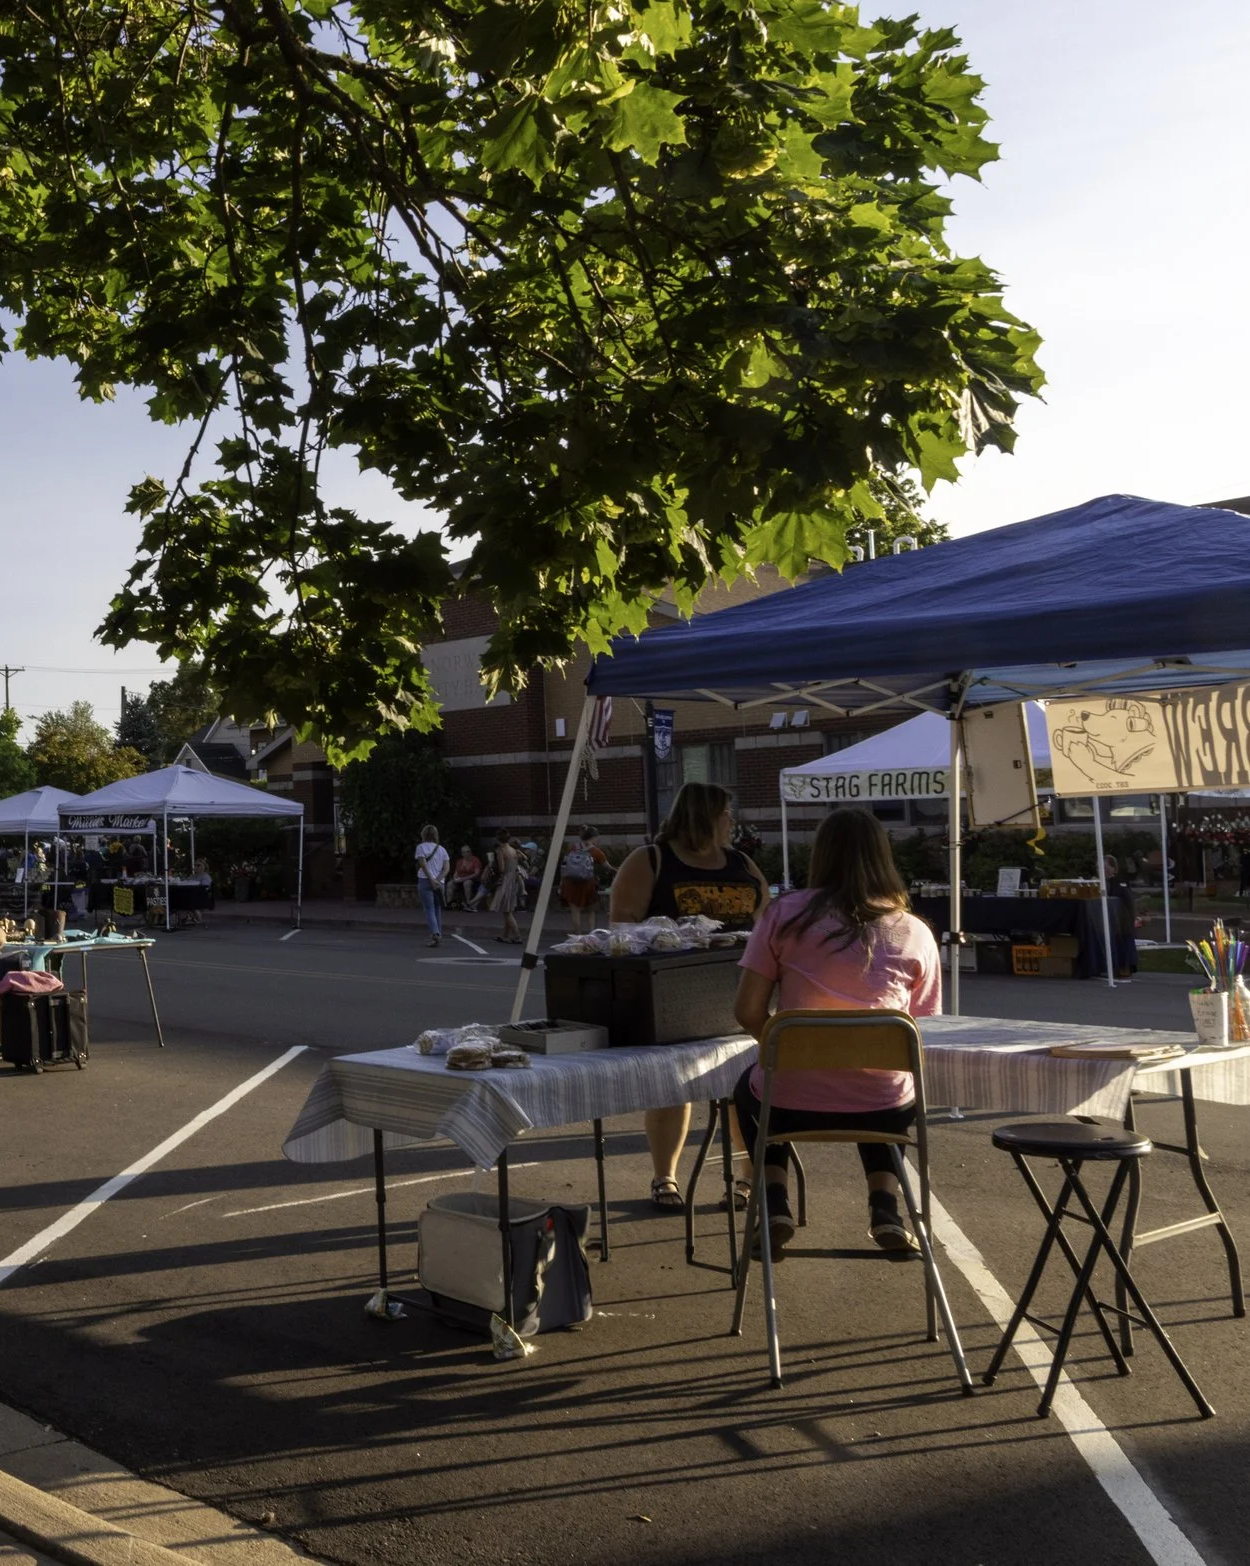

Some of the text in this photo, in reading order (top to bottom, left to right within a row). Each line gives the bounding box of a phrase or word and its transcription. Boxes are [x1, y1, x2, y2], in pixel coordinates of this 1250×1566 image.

[810, 771, 945, 798] STAG FARMS
[109, 814, 149, 829] Market
